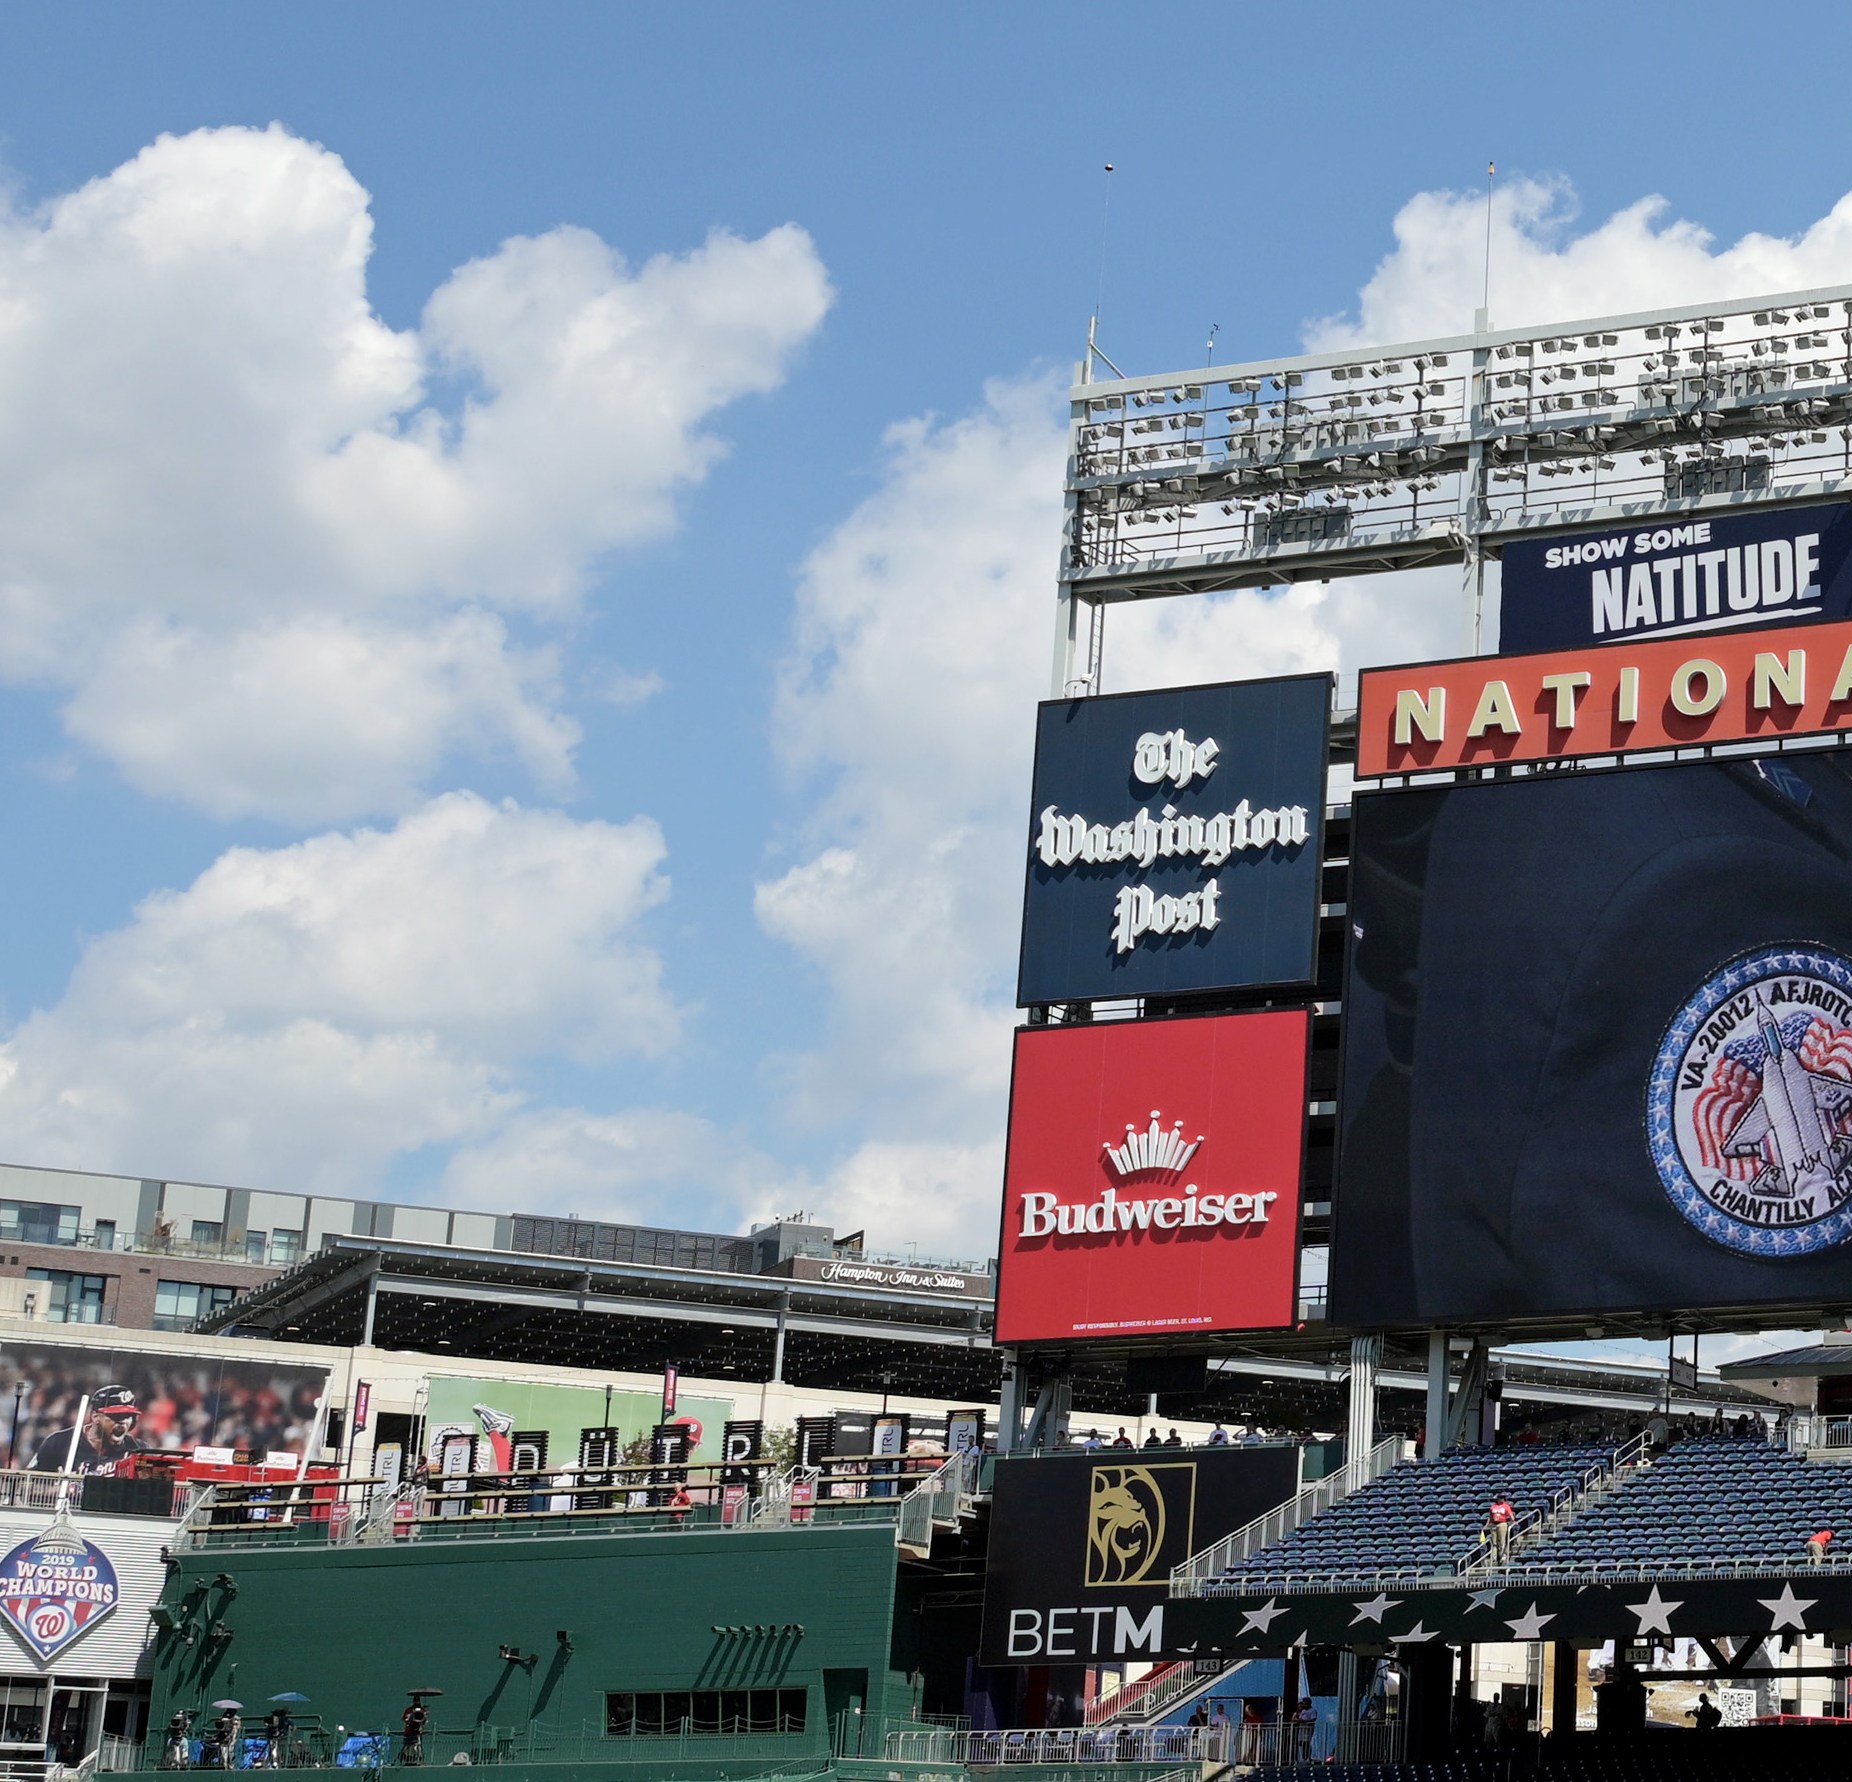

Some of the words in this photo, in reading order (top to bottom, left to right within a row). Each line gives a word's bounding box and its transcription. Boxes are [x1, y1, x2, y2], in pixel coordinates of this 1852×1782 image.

[1545, 536, 1628, 568] SHOW
[1634, 522, 1711, 554] SOME
[1592, 533, 1821, 634] NATITUDE
[1134, 728, 1219, 788] The
[1036, 799, 1310, 868] Washington
[1111, 878, 1221, 954] Post
[1681, 996, 1755, 1091] VA-20012
[1019, 1184, 1277, 1237] Budweiser
[1709, 1179, 1815, 1223] CHANTILLY
[821, 1262, 888, 1283] Hampton
[889, 1270, 922, 1286] Inn
[930, 1273, 965, 1288] Suites
[16, 1560, 98, 1582] WORLD
[41, 1553, 75, 1567] 2019
[1007, 1605, 1225, 1657] BETM
[1630, 1650, 1648, 1660] 142
[1200, 1662, 1217, 1672] 143
